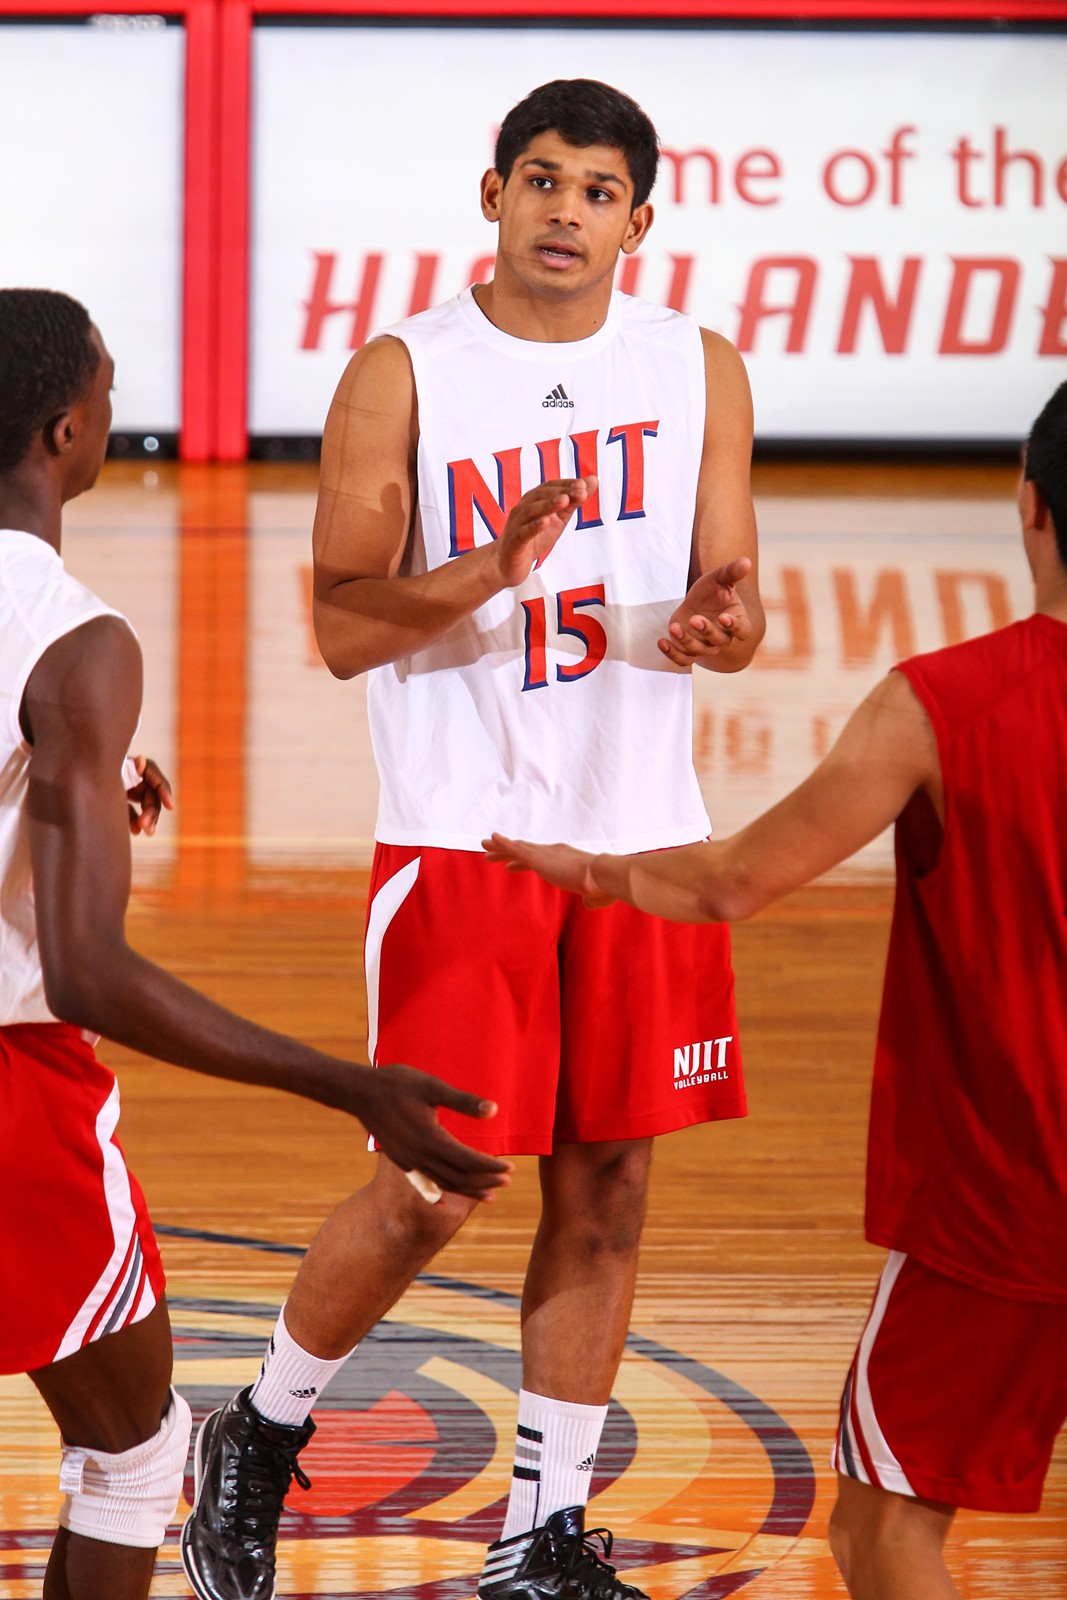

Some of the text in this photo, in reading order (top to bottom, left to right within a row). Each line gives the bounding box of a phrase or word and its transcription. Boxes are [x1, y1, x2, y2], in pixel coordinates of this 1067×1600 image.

[822, 124, 918, 207] of
[951, 124, 1067, 208] th
[542, 399, 574, 408] adidas
[521, 583, 607, 691] 15
[673, 1036, 733, 1079] NJIT
[673, 1071, 729, 1091] VOLLEYBALL
